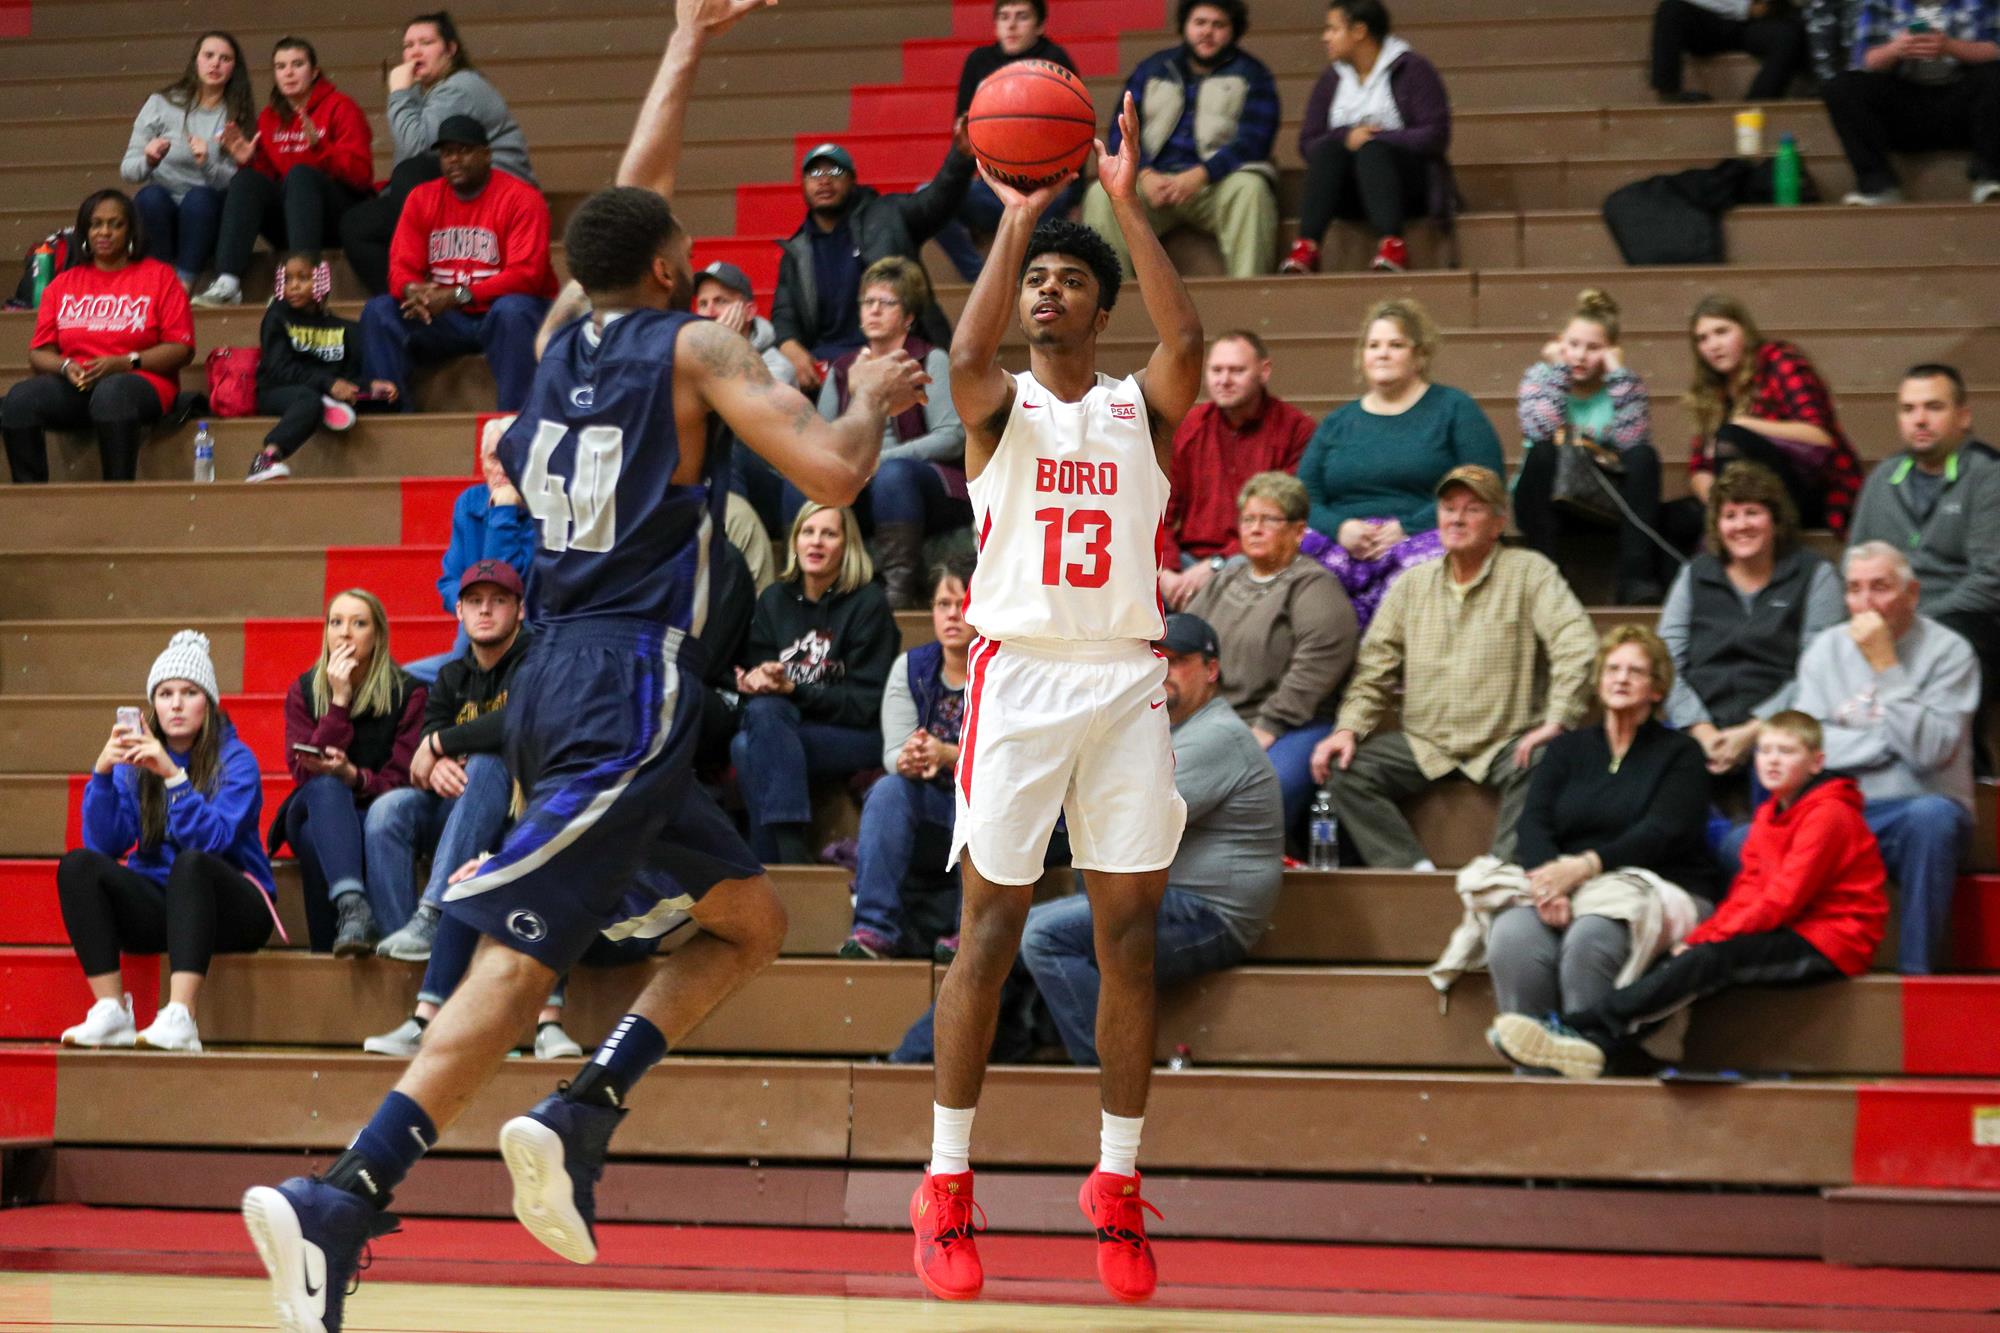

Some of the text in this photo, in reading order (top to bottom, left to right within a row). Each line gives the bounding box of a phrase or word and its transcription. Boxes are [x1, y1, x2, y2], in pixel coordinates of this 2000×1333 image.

[58, 294, 150, 328] MOM
[1110, 407, 1136, 416] PSAC
[521, 419, 623, 552] 40
[1035, 457, 1118, 496] BORO
[1035, 507, 1112, 589] 13
